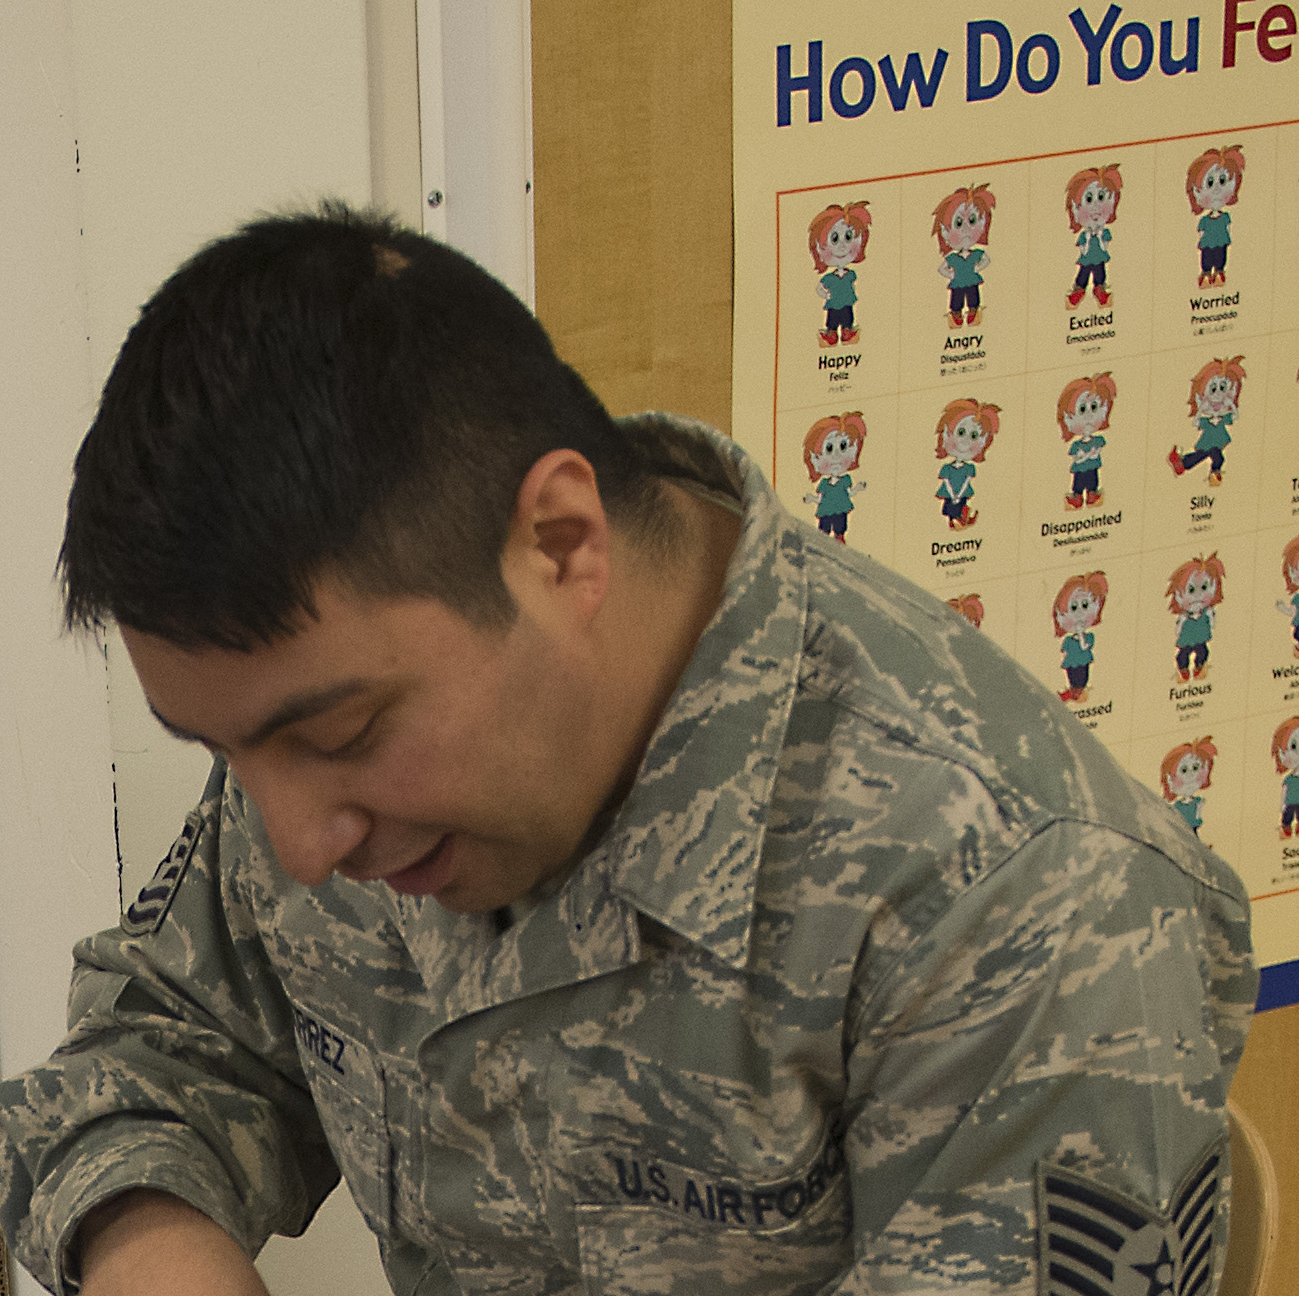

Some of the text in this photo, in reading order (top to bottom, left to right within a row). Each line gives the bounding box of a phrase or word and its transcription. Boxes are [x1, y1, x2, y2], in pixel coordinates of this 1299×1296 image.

[776, 40, 949, 127] How
[965, 19, 1060, 103] Do
[1068, 3, 1200, 87] You
[1190, 291, 1240, 310] Worried
[1069, 311, 1114, 331] Excited
[943, 334, 983, 350] Angry
[818, 354, 862, 370] Happy
[1190, 495, 1214, 511] Silly
[1041, 511, 1123, 537] Disappointed
[931, 538, 983, 556] Dreamy
[1169, 684, 1212, 700] Furious
[615, 1157, 679, 1207] U.S.
[684, 1178, 745, 1225] AIR
